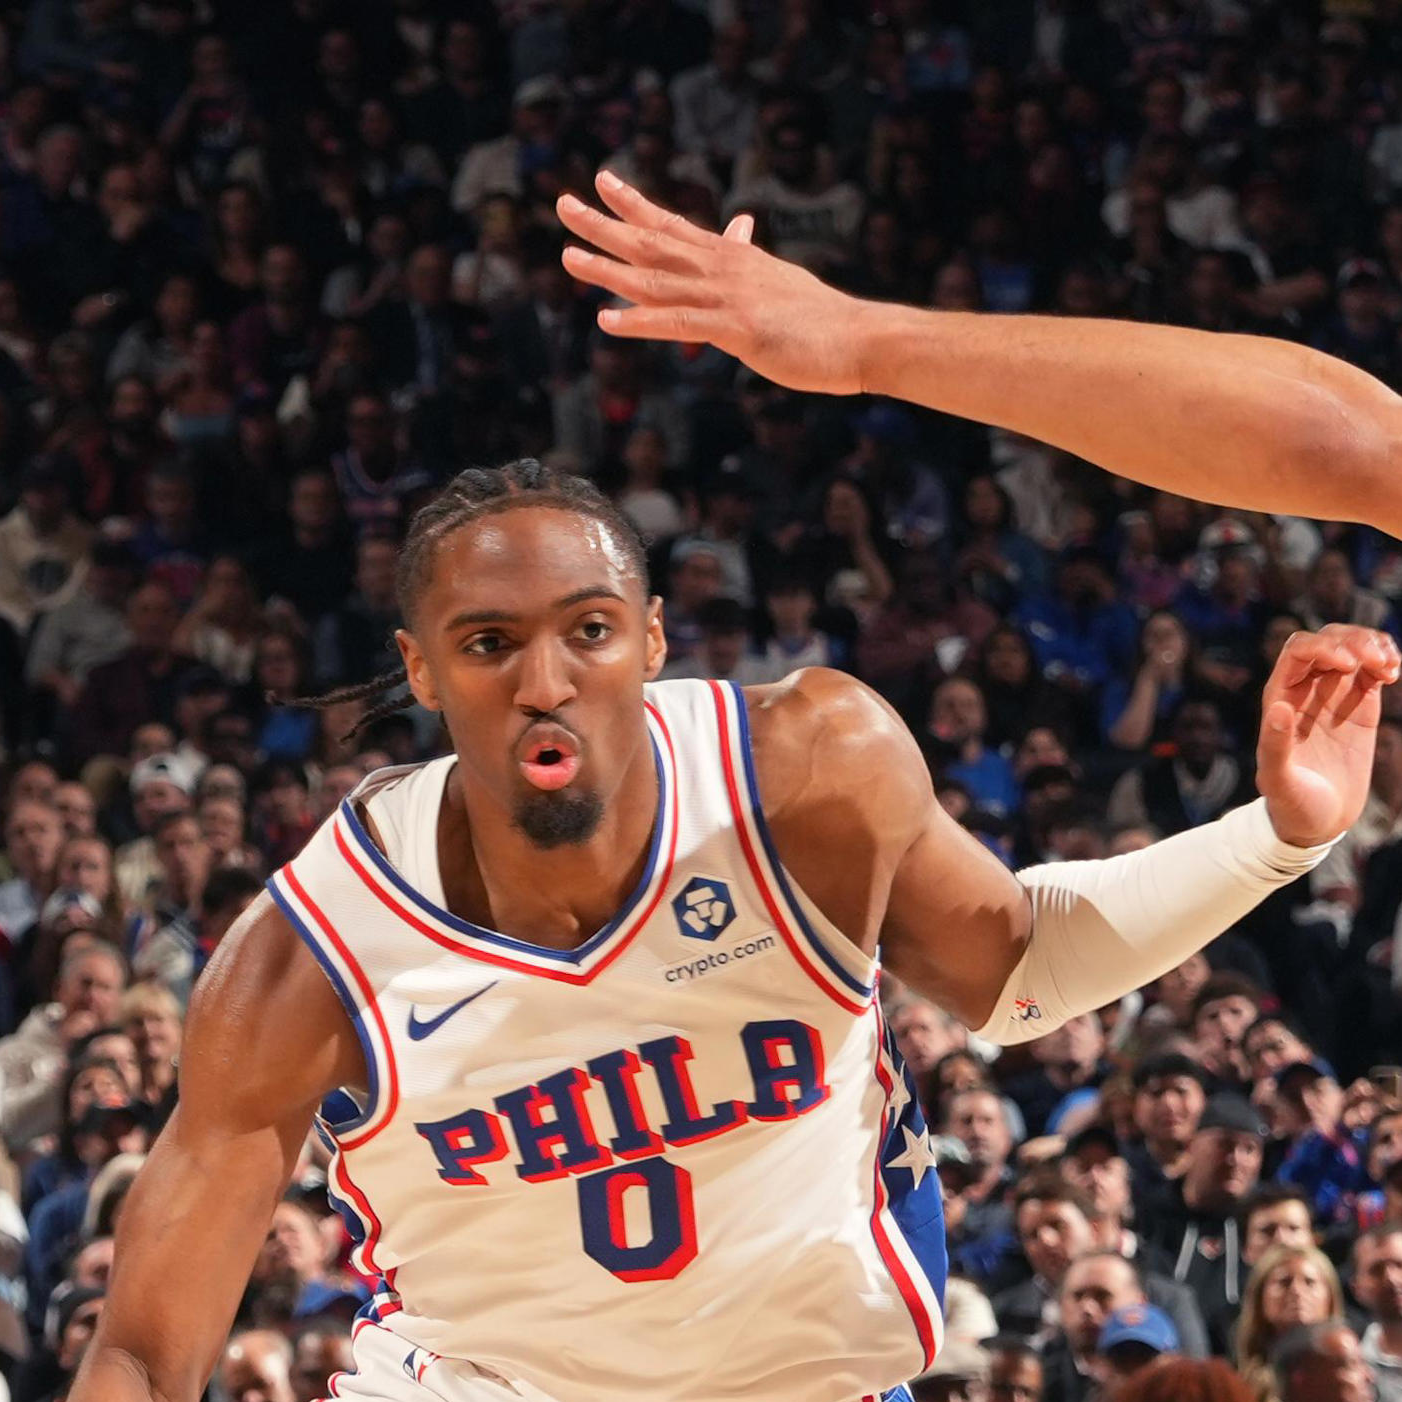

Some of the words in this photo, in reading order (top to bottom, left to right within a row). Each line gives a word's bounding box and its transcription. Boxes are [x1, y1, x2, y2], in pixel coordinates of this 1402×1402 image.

[665, 936, 775, 981] crypto.com
[415, 1019, 831, 1186] PHILA
[577, 1157, 699, 1283] 0
